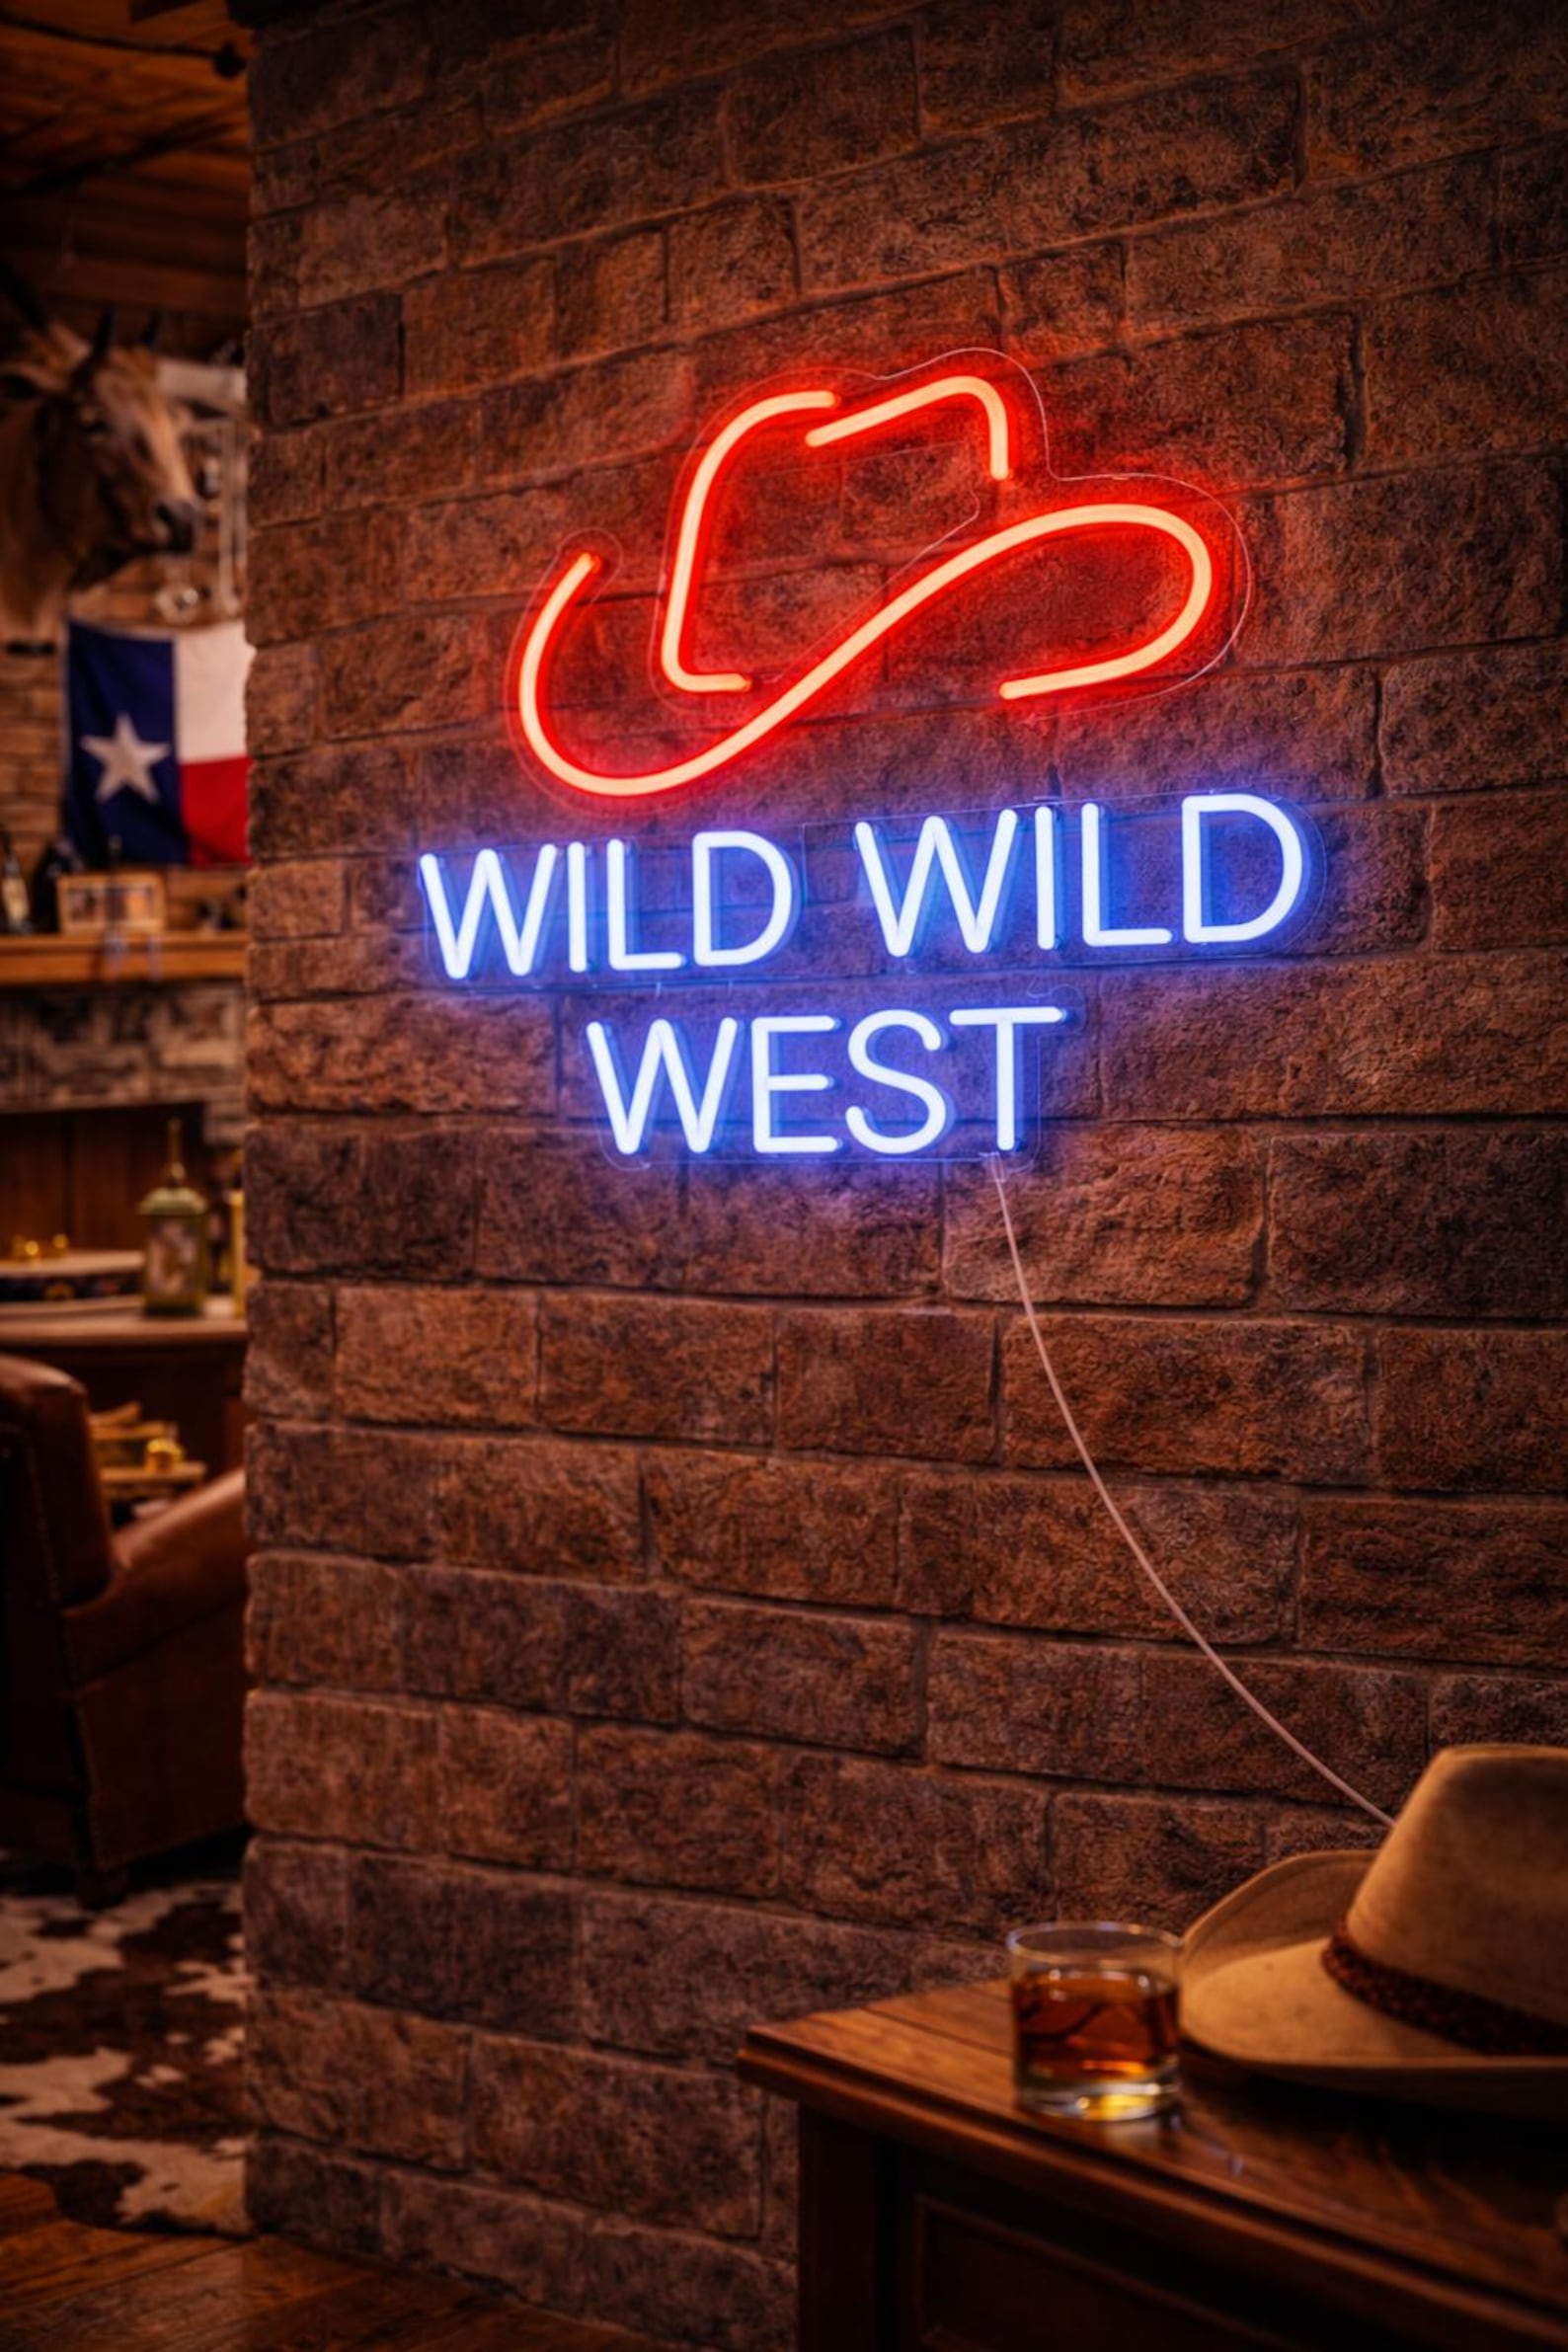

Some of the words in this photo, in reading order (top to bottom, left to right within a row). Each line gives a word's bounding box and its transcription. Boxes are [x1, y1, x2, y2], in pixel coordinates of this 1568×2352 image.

[418, 829, 793, 980] WILD
[853, 792, 1304, 959] WILD
[585, 1005, 1065, 1155] WEST
